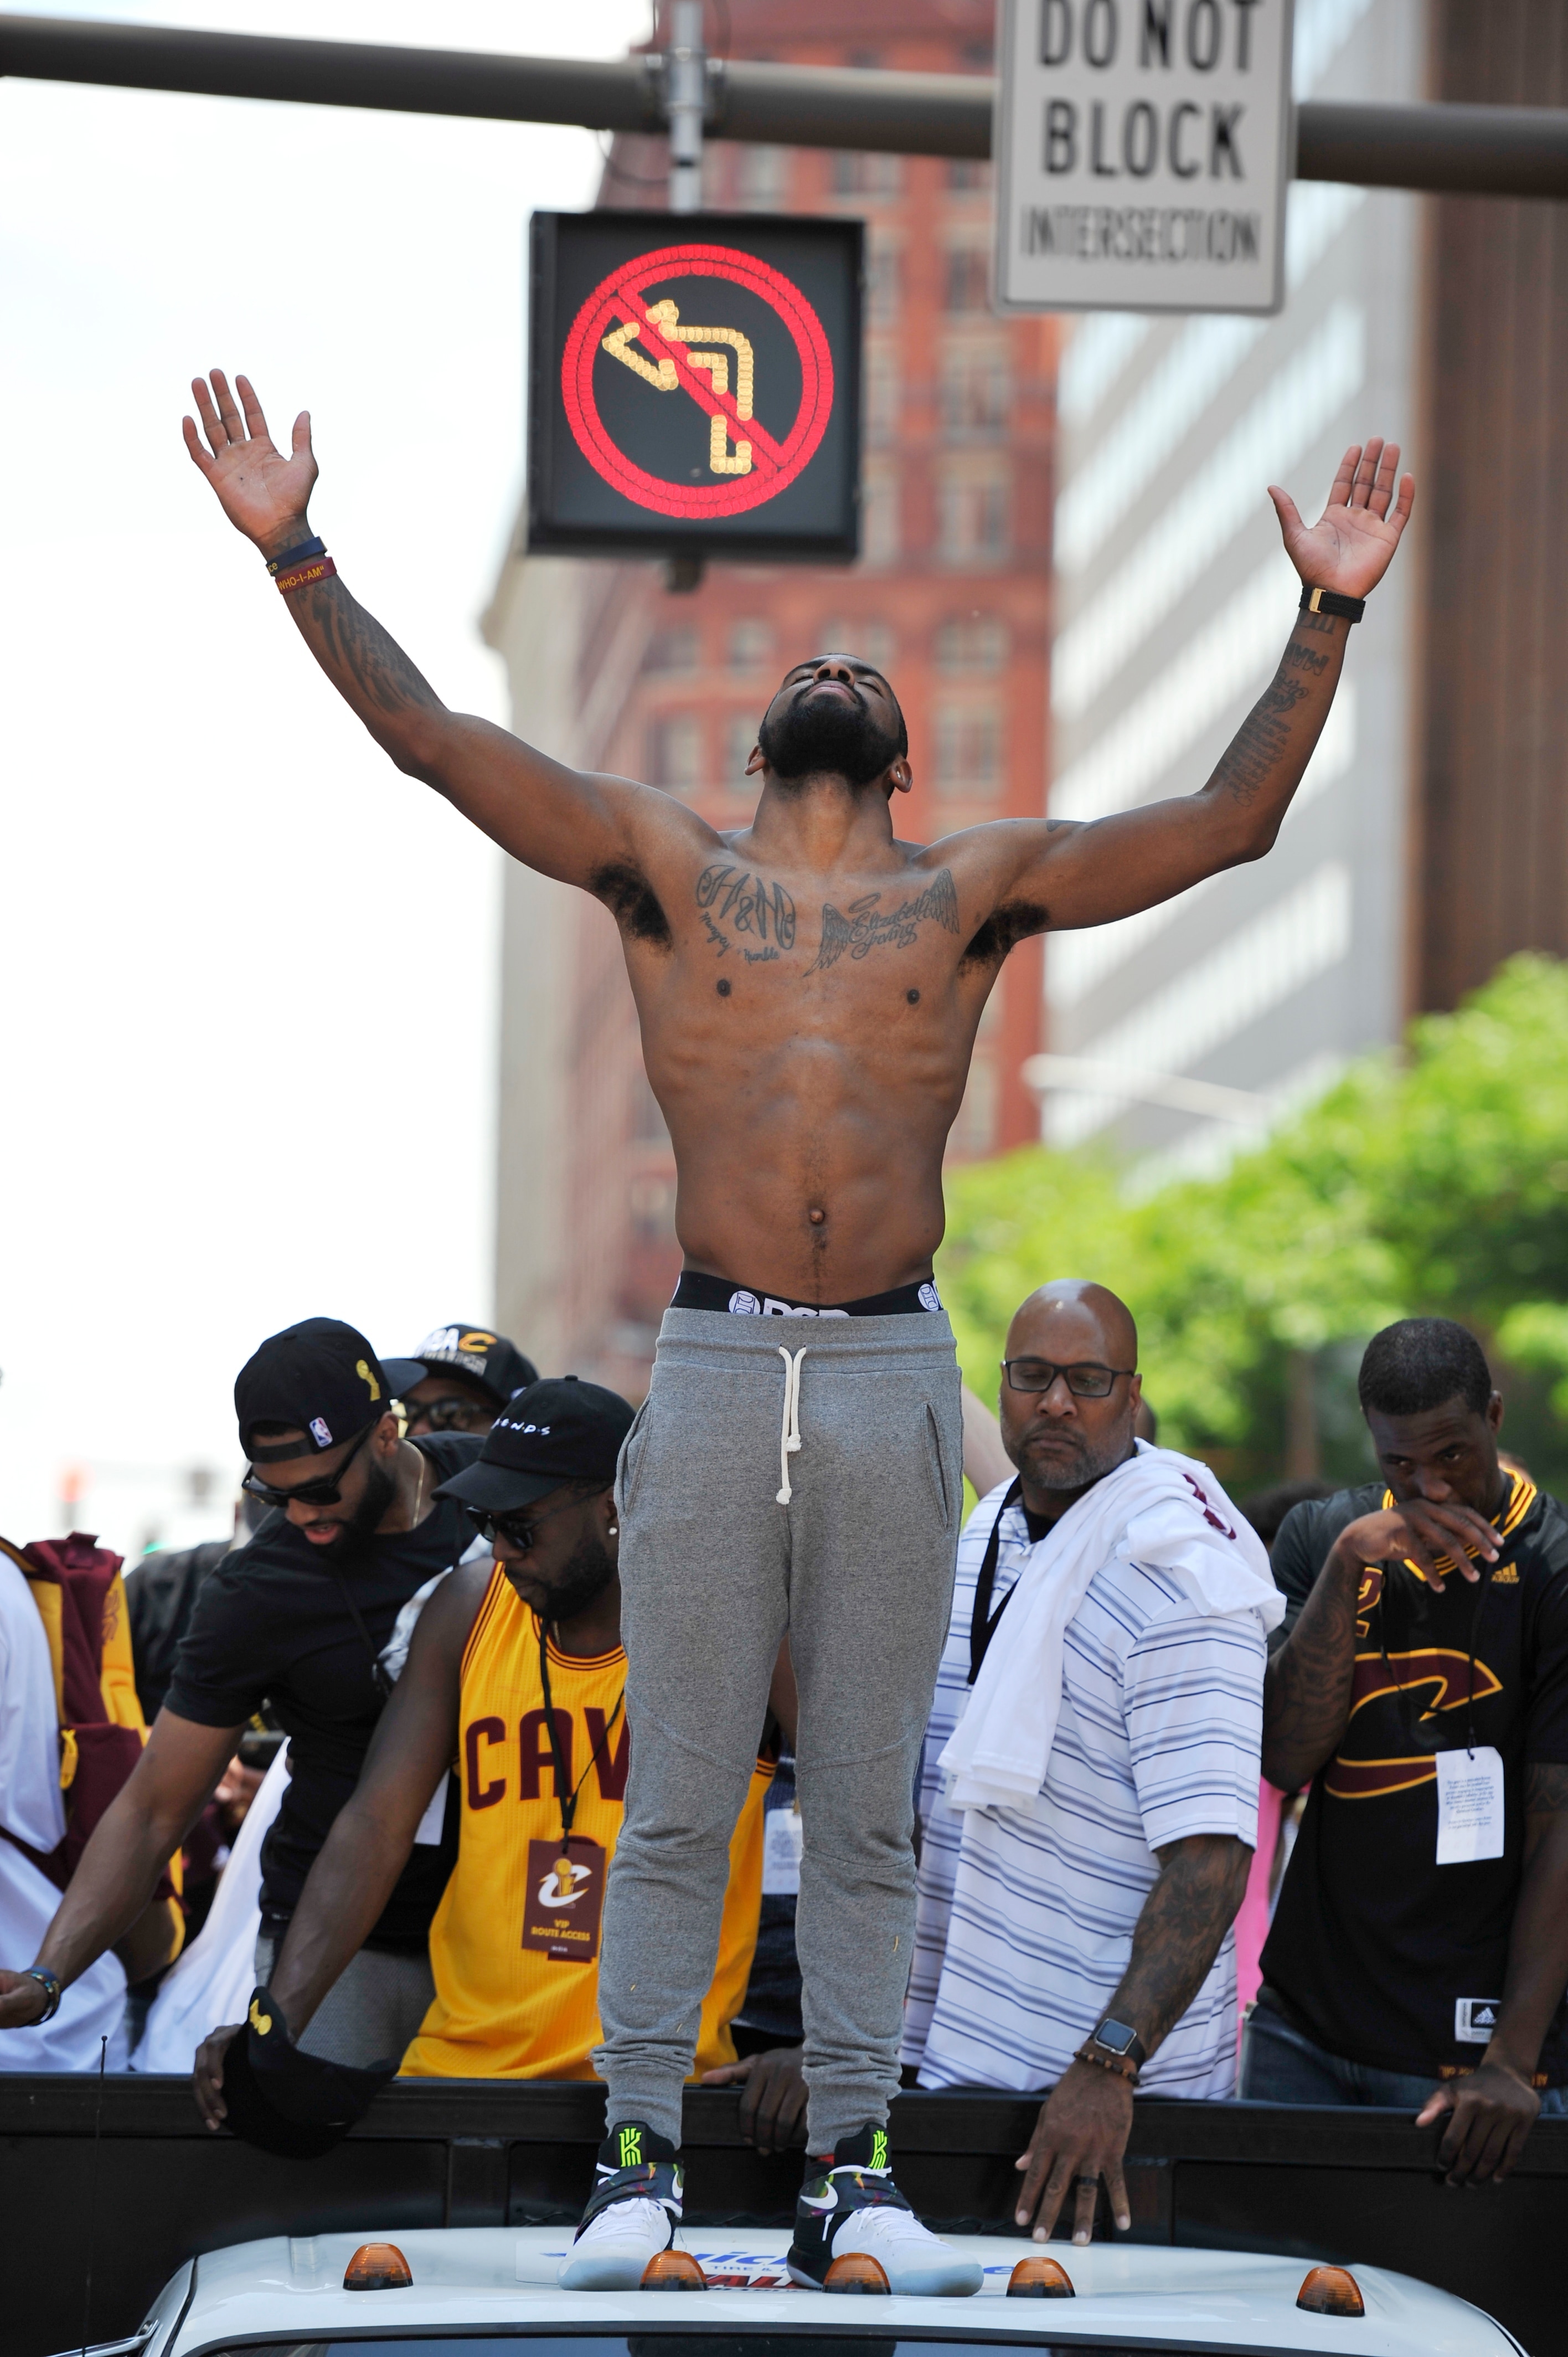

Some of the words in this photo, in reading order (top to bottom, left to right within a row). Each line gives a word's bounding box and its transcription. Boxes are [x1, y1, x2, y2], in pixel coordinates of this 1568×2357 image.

[1039, 0, 1117, 69] DO
[1139, 0, 1265, 73] NOT
[1044, 99, 1246, 179] BLOCK
[1020, 204, 1260, 262] INTERSECTION
[531, 1926, 559, 1937] ROUTE
[560, 1929, 591, 1942] ACCESS
[554, 1919, 570, 1928] VIP
